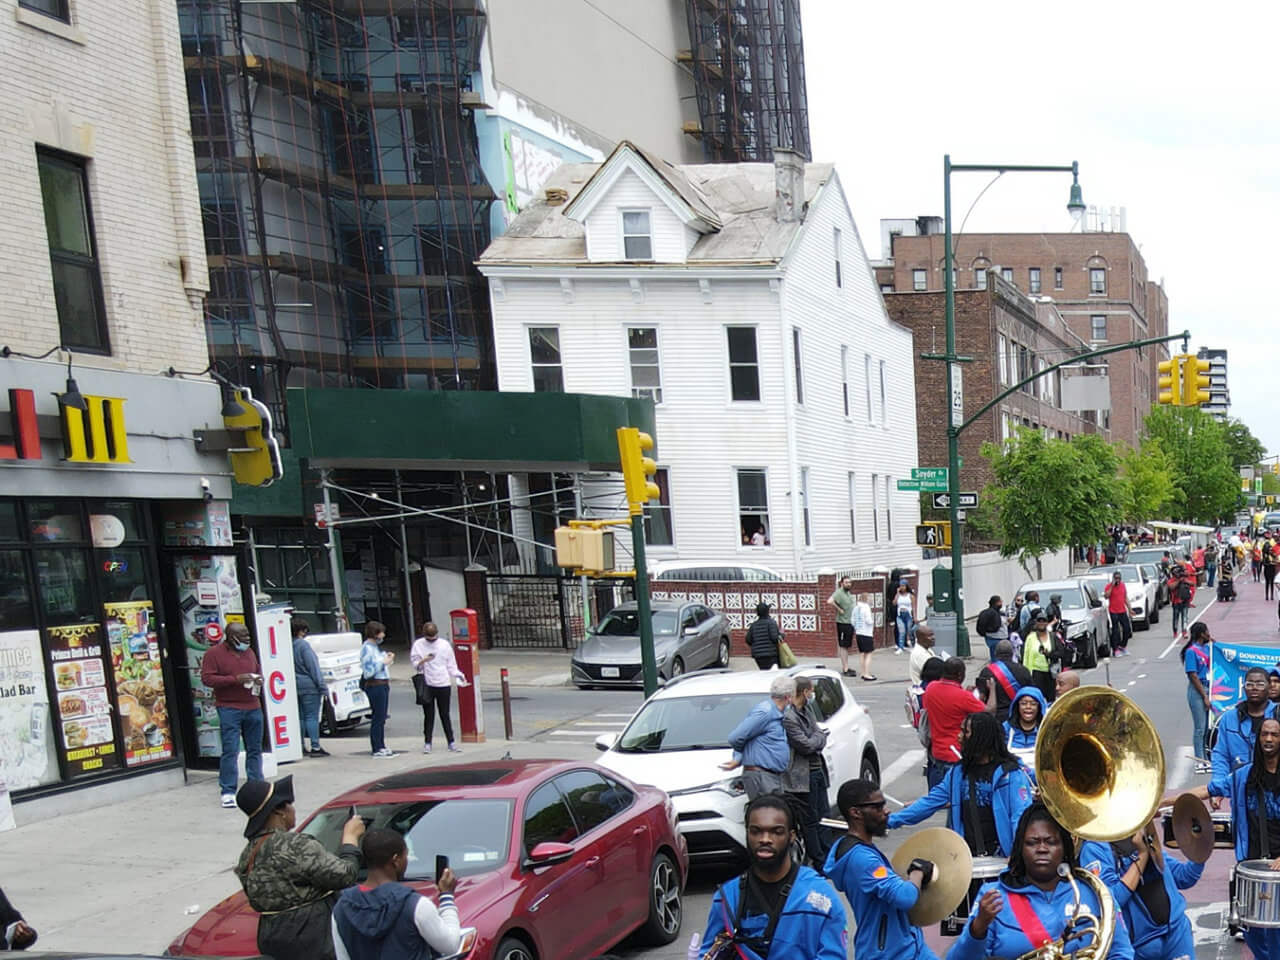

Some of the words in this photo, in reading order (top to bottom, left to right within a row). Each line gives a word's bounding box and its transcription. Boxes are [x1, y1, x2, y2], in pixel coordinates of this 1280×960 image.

[915, 469, 937, 480] Snyder
[18, 683, 36, 696] Bar
[267, 626, 290, 747] ICE
